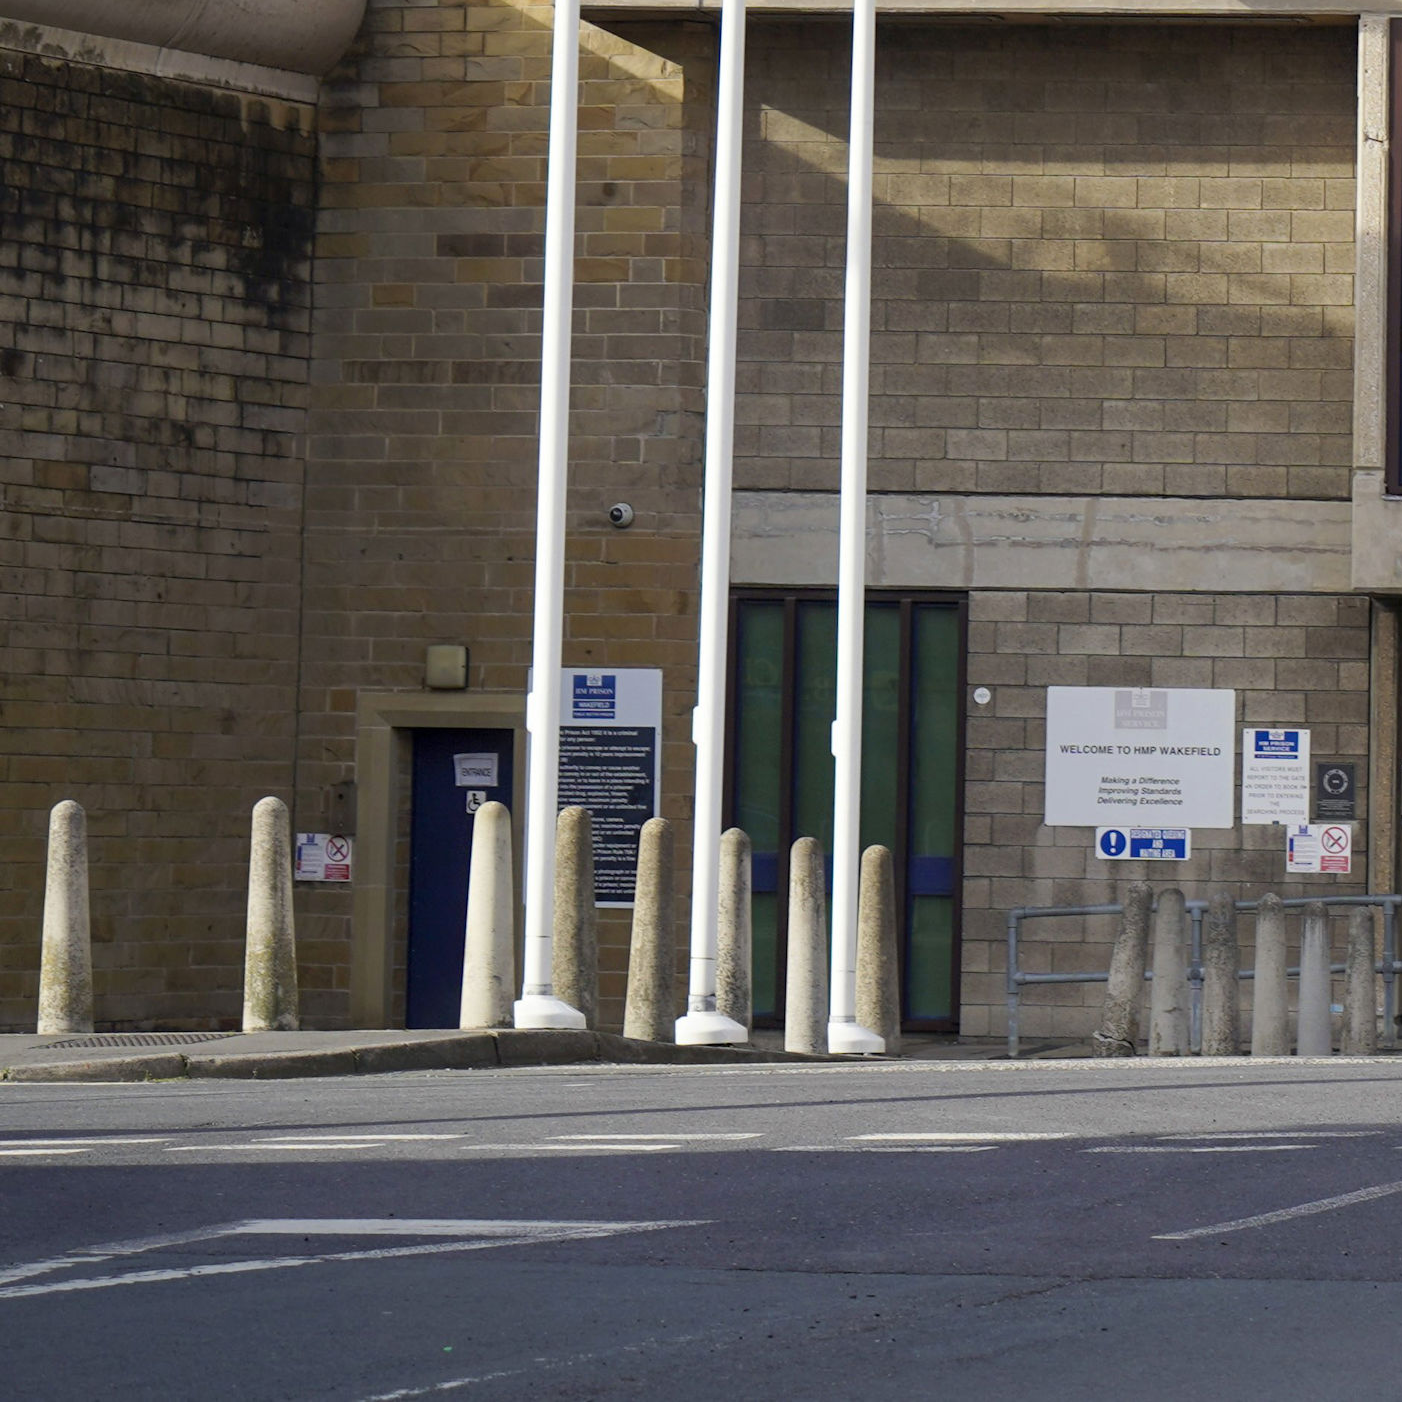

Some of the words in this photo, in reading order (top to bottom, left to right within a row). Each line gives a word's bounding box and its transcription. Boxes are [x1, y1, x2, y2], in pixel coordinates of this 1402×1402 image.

[1060, 745, 1113, 755] WELCOME
[1117, 746, 1131, 755] TO
[1134, 746, 1157, 755] HMP
[1159, 746, 1221, 756] WAKEFIELD
[462, 767, 492, 778] ENTRANCE
[1101, 776, 1130, 786] Making
[1138, 776, 1180, 785] Difference
[1098, 786, 1139, 796] Improving
[1141, 786, 1182, 796] Standards
[1097, 796, 1138, 806] Delivering
[1139, 797, 1183, 806] Excellence
